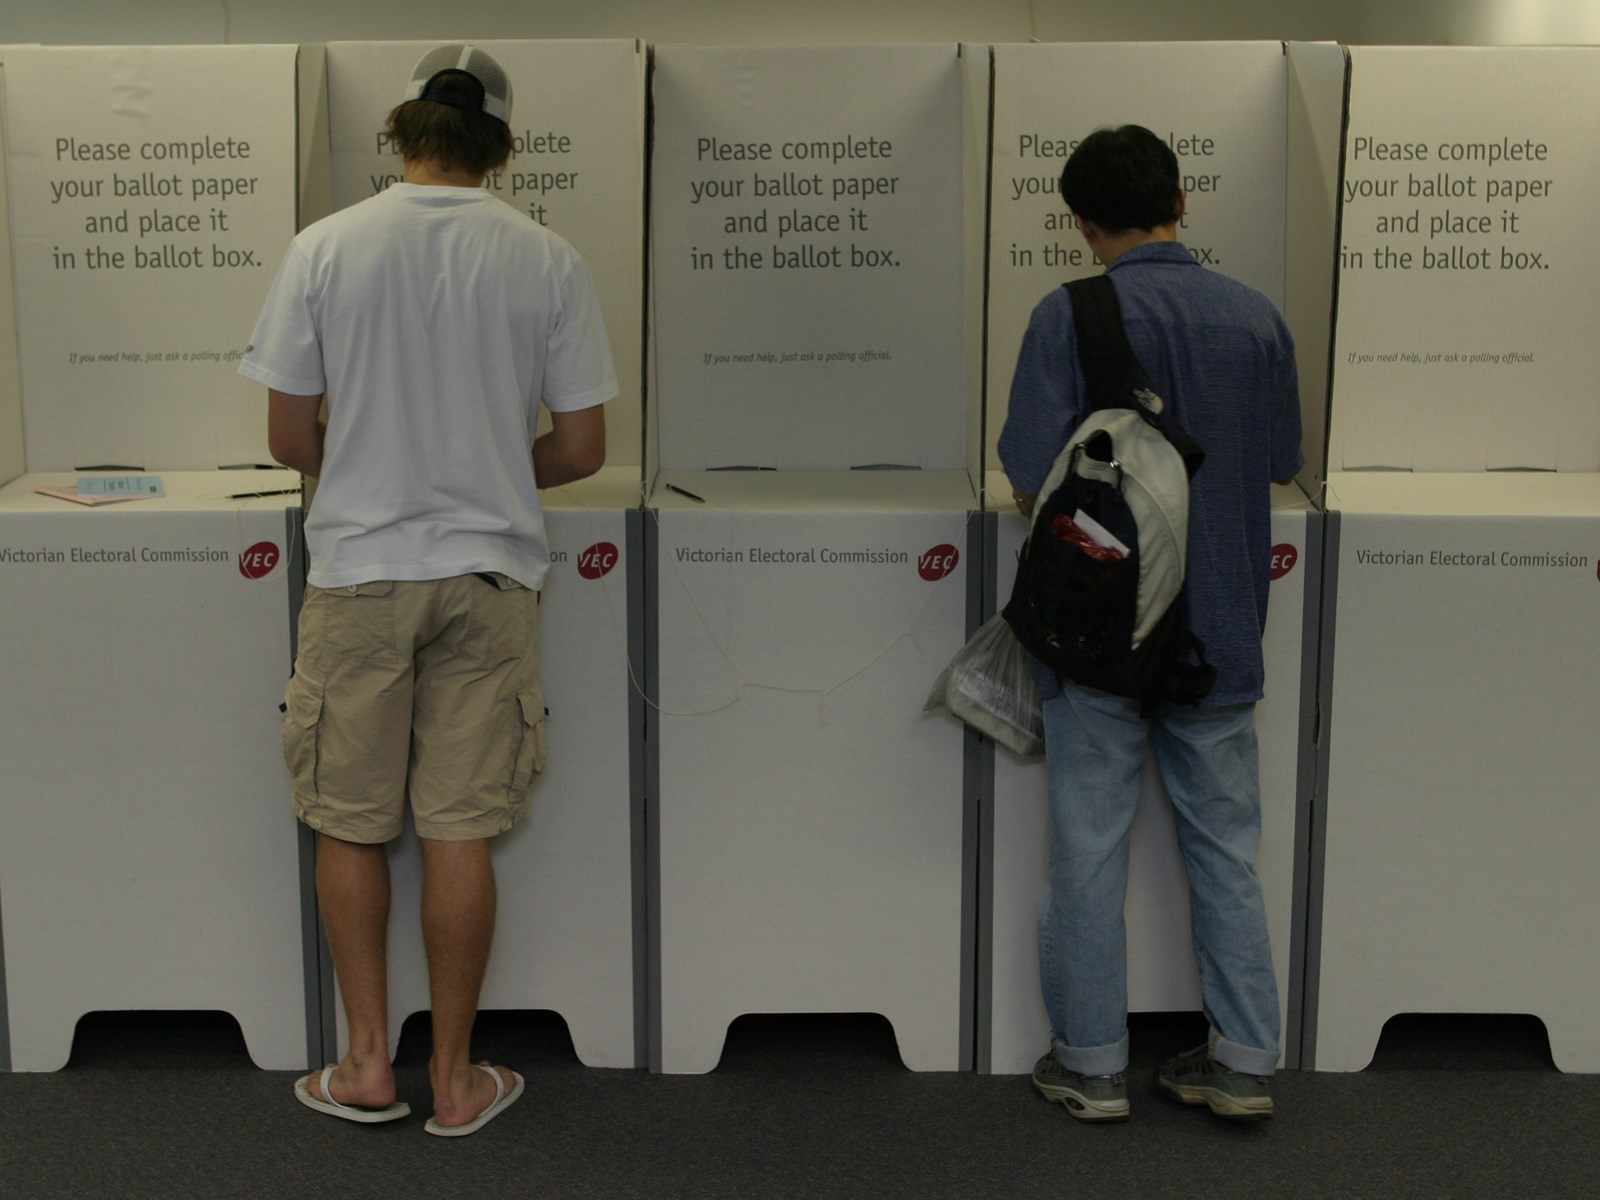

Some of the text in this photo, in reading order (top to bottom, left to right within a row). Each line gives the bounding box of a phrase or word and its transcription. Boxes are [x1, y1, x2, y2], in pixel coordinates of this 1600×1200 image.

[57, 135, 250, 165] Please complete
[512, 129, 571, 160] plete
[698, 135, 892, 165] Please complete
[1019, 133, 1079, 158] Pleas
[1355, 136, 1548, 166] Please complete
[50, 174, 258, 204] your ballot paper
[512, 172, 578, 197] paper
[691, 174, 899, 204] your ballot paper
[1344, 174, 1553, 204] your ballot paper
[86, 208, 228, 239] and place it
[528, 202, 548, 227] it
[725, 208, 869, 239] and place it
[1044, 212, 1081, 231] an
[1377, 209, 1520, 239] and place it
[53, 243, 262, 269] in the ballot box.
[691, 243, 901, 269] in the ballot box.
[1010, 243, 1032, 267] in
[1043, 243, 1082, 267] the
[1341, 245, 1550, 270] in the ballot box.
[68, 352, 77, 364] If
[79, 355, 96, 364] you
[98, 352, 119, 362] need
[121, 352, 143, 364] help,
[145, 352, 163, 364] just
[165, 352, 180, 362] ask
[191, 352, 221, 364] polling
[703, 351, 892, 364] If you need help, just ask a polling official.
[1347, 352, 1356, 364] If
[1357, 355, 1374, 364] you
[1376, 352, 1398, 362] need
[1400, 352, 1422, 364] help,
[1423, 352, 1442, 364] just
[1444, 352, 1459, 362] ask
[1469, 352, 1500, 364] polling
[1502, 352, 1536, 364] official.
[0, 547, 229, 563] Victorian Electoral Commission
[676, 547, 908, 564] Victorian Electoral Commission
[1357, 549, 1588, 568] Victorian Electoral Commission
